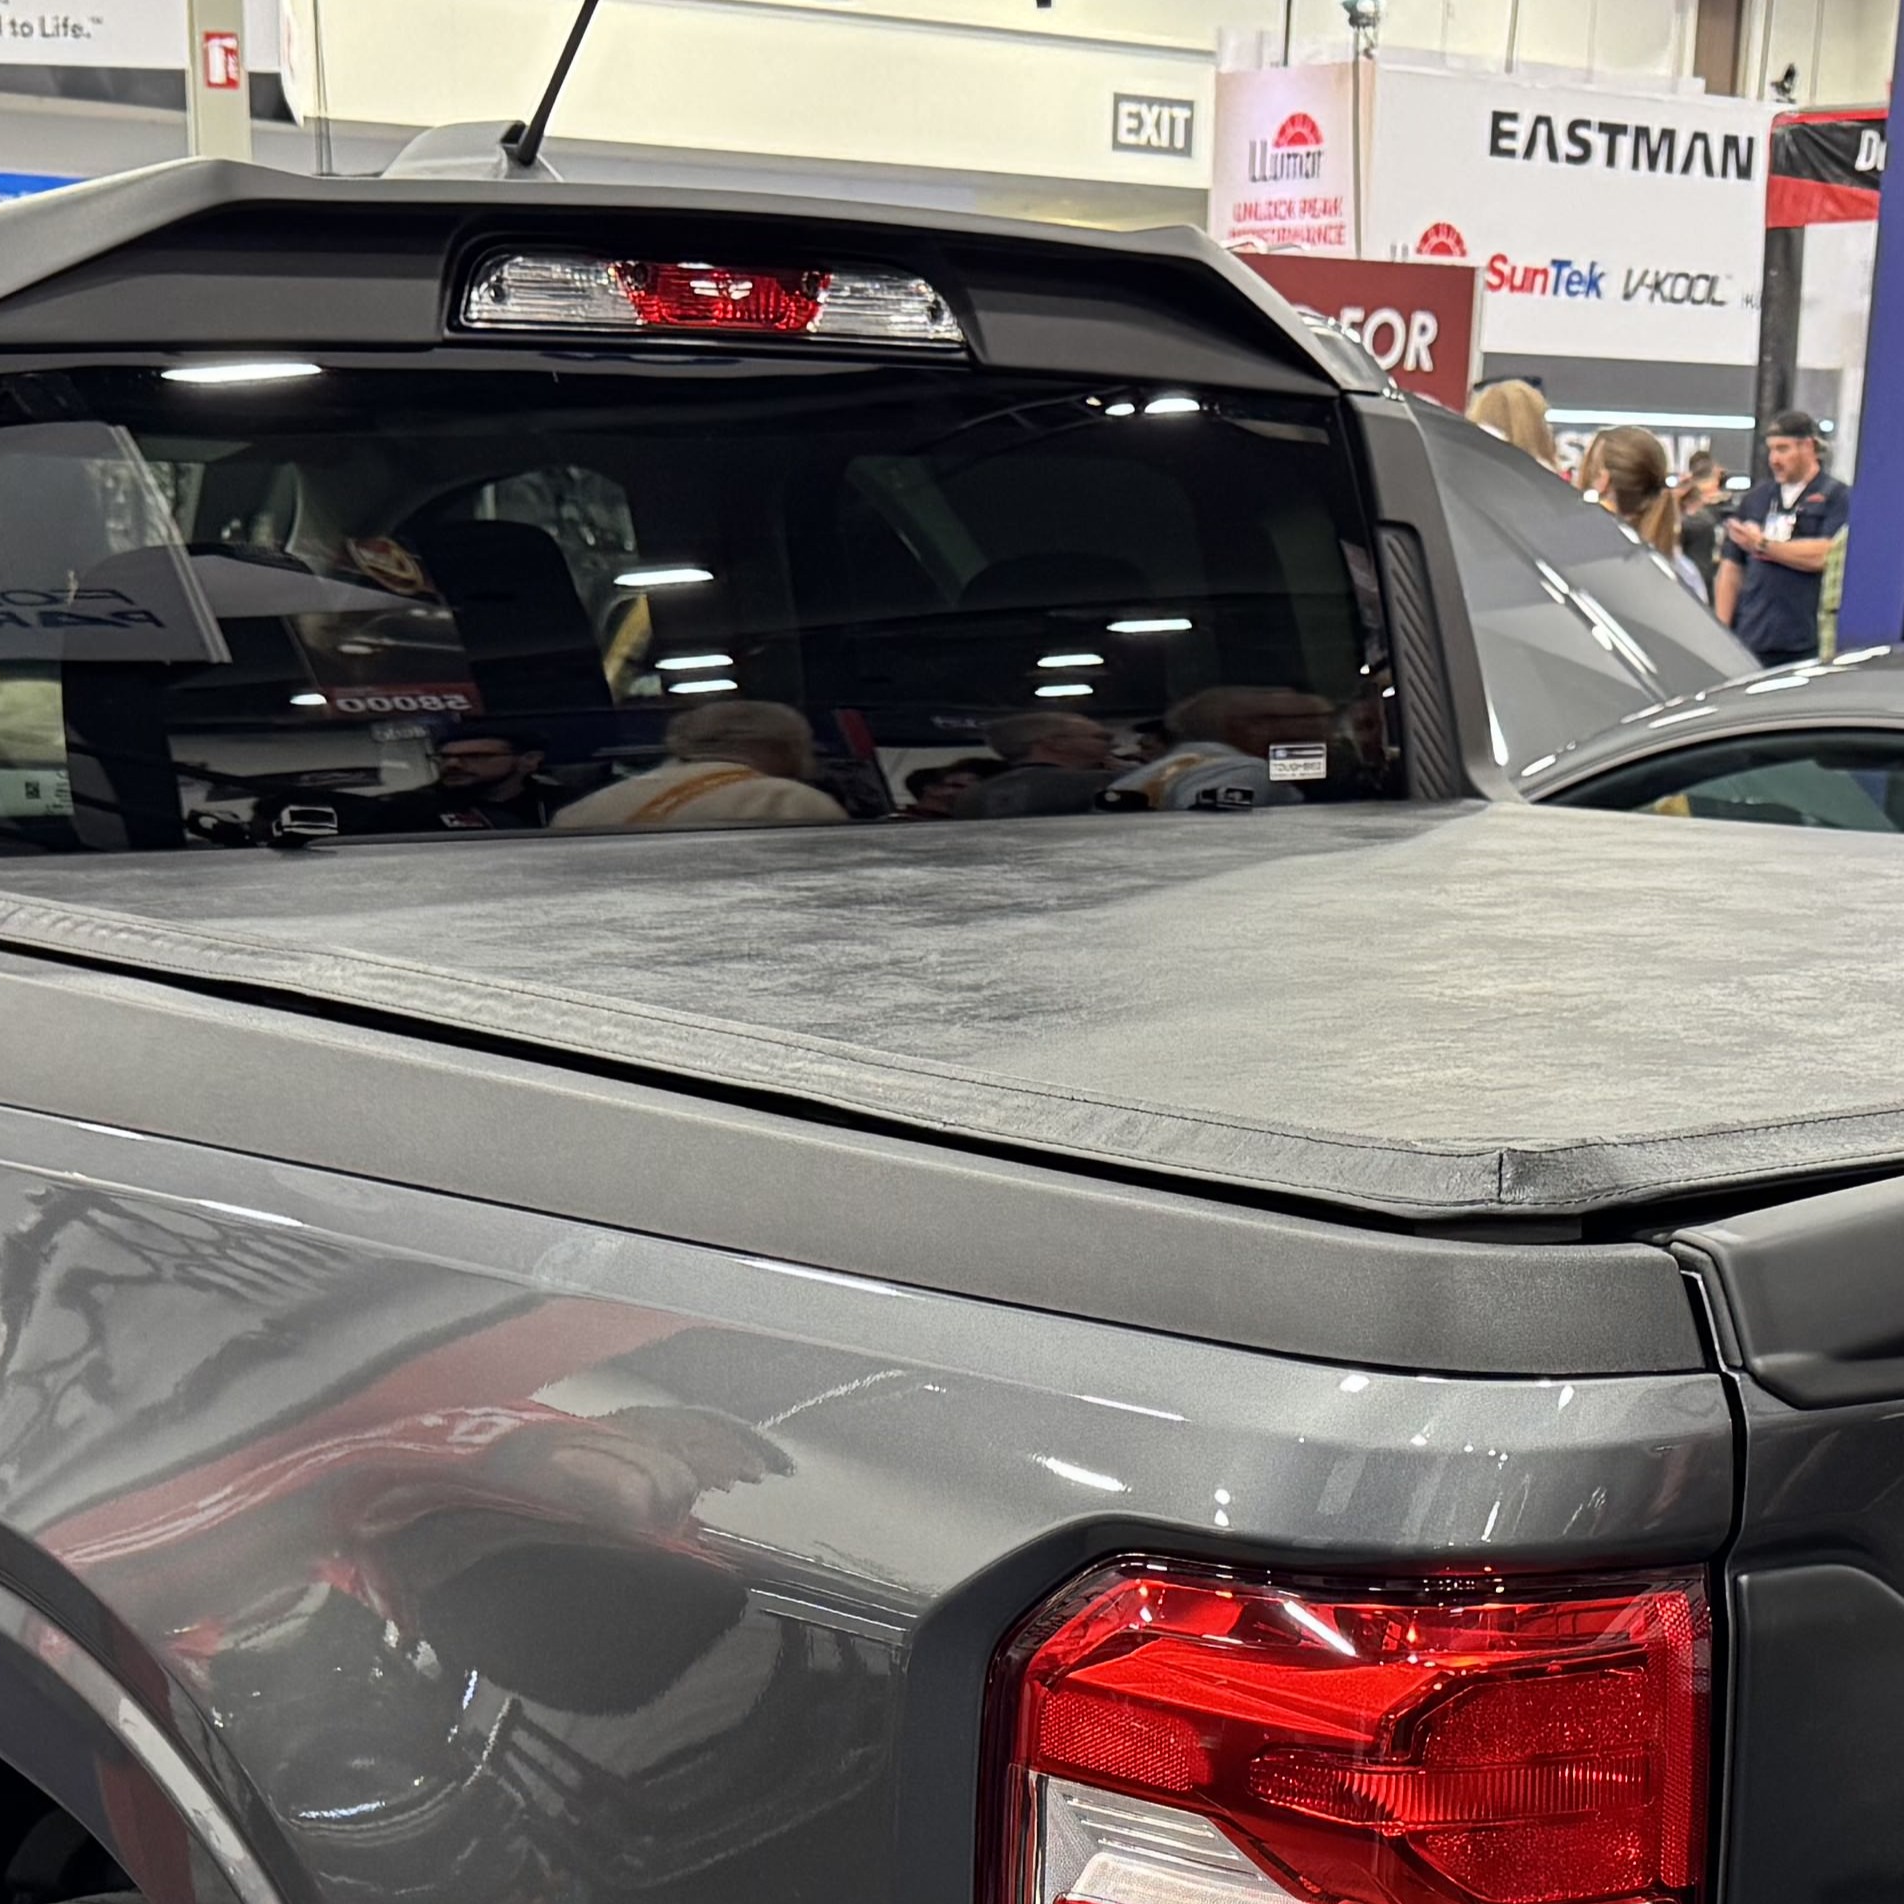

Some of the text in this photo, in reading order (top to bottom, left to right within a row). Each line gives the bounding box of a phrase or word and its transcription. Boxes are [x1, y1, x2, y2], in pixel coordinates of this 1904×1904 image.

[10, 17, 34, 38] to
[1117, 99, 1192, 149] EXIT
[1488, 109, 1756, 182] EASTMAN
[1485, 253, 1604, 300] SunTek
